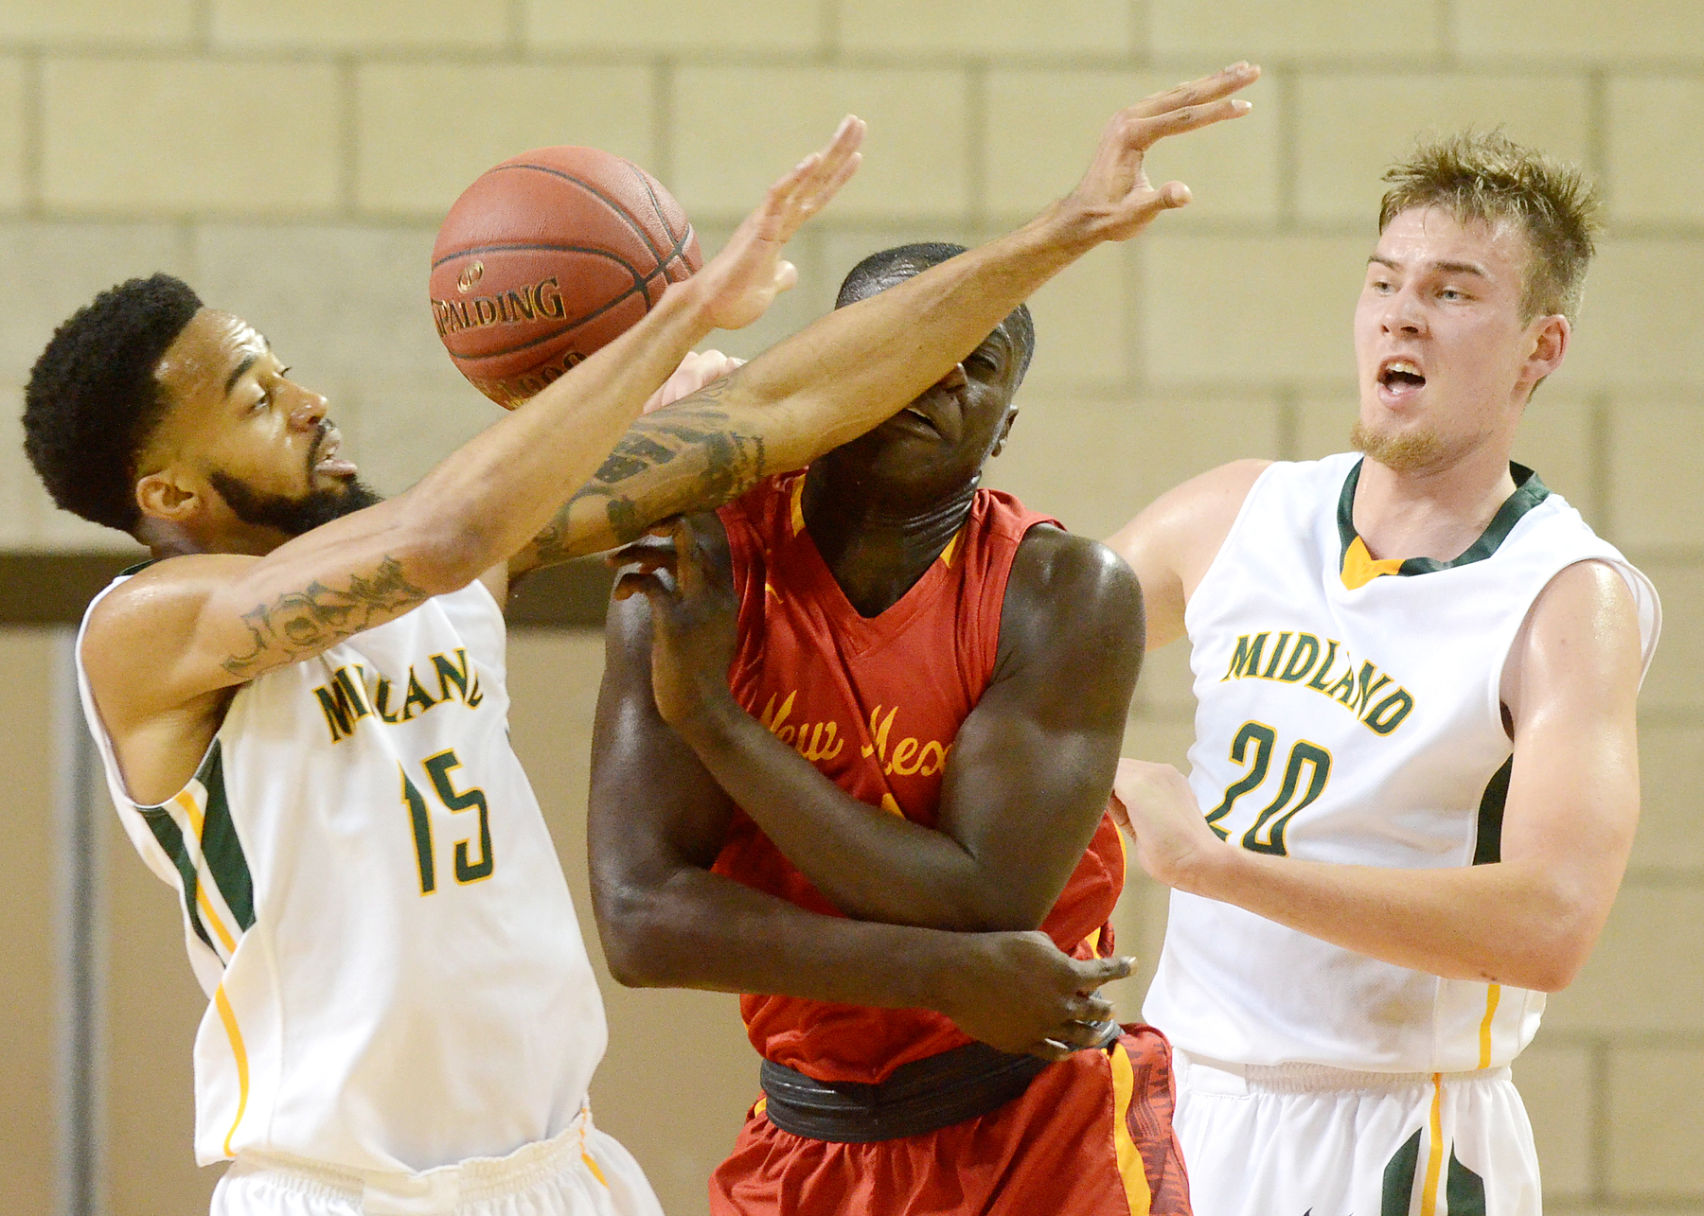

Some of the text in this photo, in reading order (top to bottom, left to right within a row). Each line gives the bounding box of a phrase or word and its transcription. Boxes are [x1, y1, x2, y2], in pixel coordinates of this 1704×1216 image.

[759, 689, 845, 762] New
[1219, 630, 1416, 737] MIDLAND
[397, 747, 495, 897] 15
[1204, 719, 1333, 858] 20
